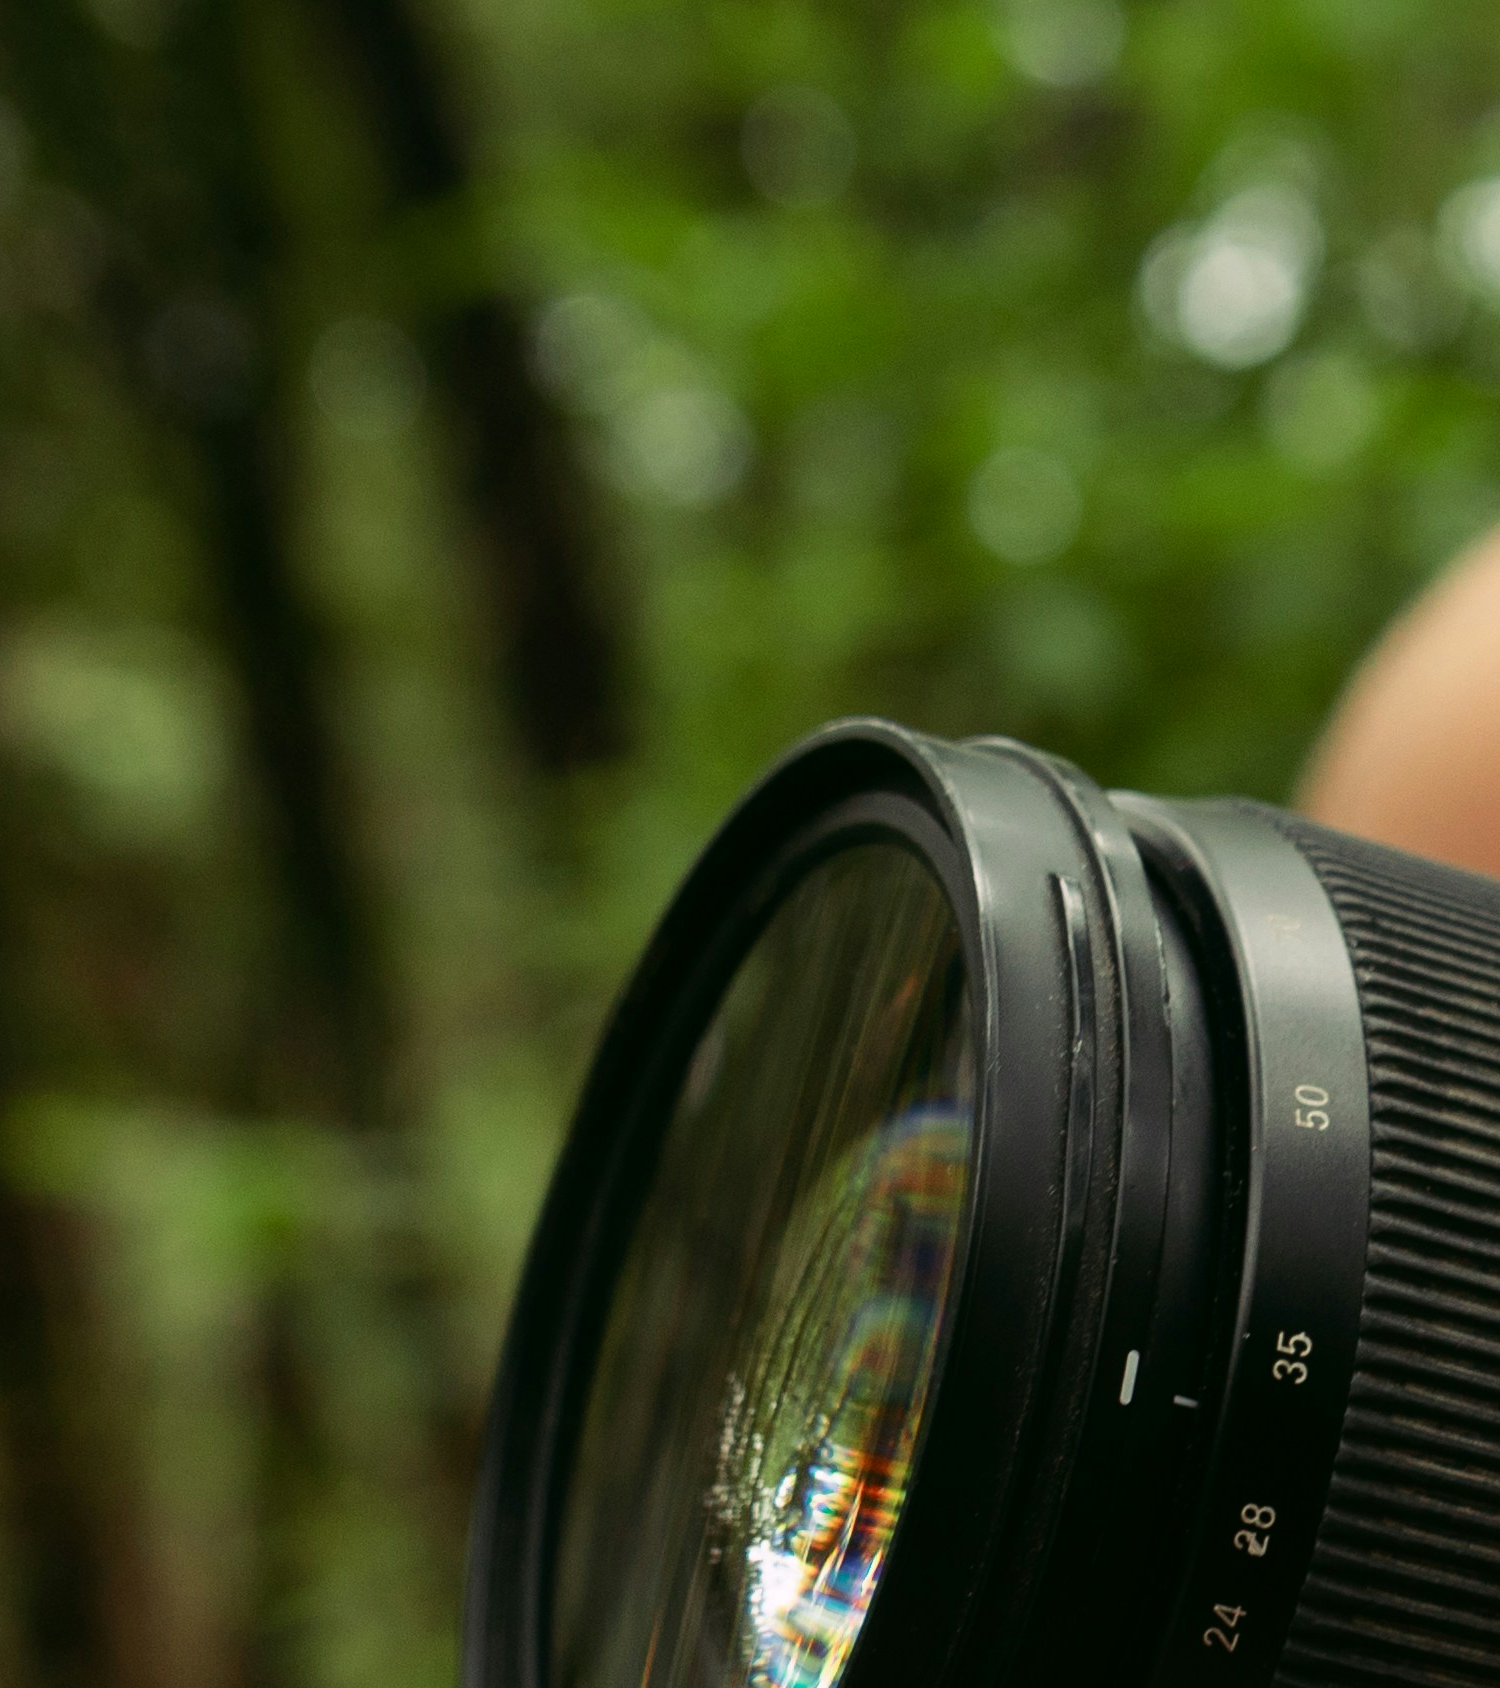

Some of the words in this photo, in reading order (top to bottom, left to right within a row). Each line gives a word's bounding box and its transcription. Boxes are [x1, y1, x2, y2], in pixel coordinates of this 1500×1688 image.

[1202, 1602, 1248, 1653] 24
[1232, 1502, 1277, 1557] 28
[1271, 1330, 1314, 1386] 35
[1293, 1082, 1331, 1132] 50
